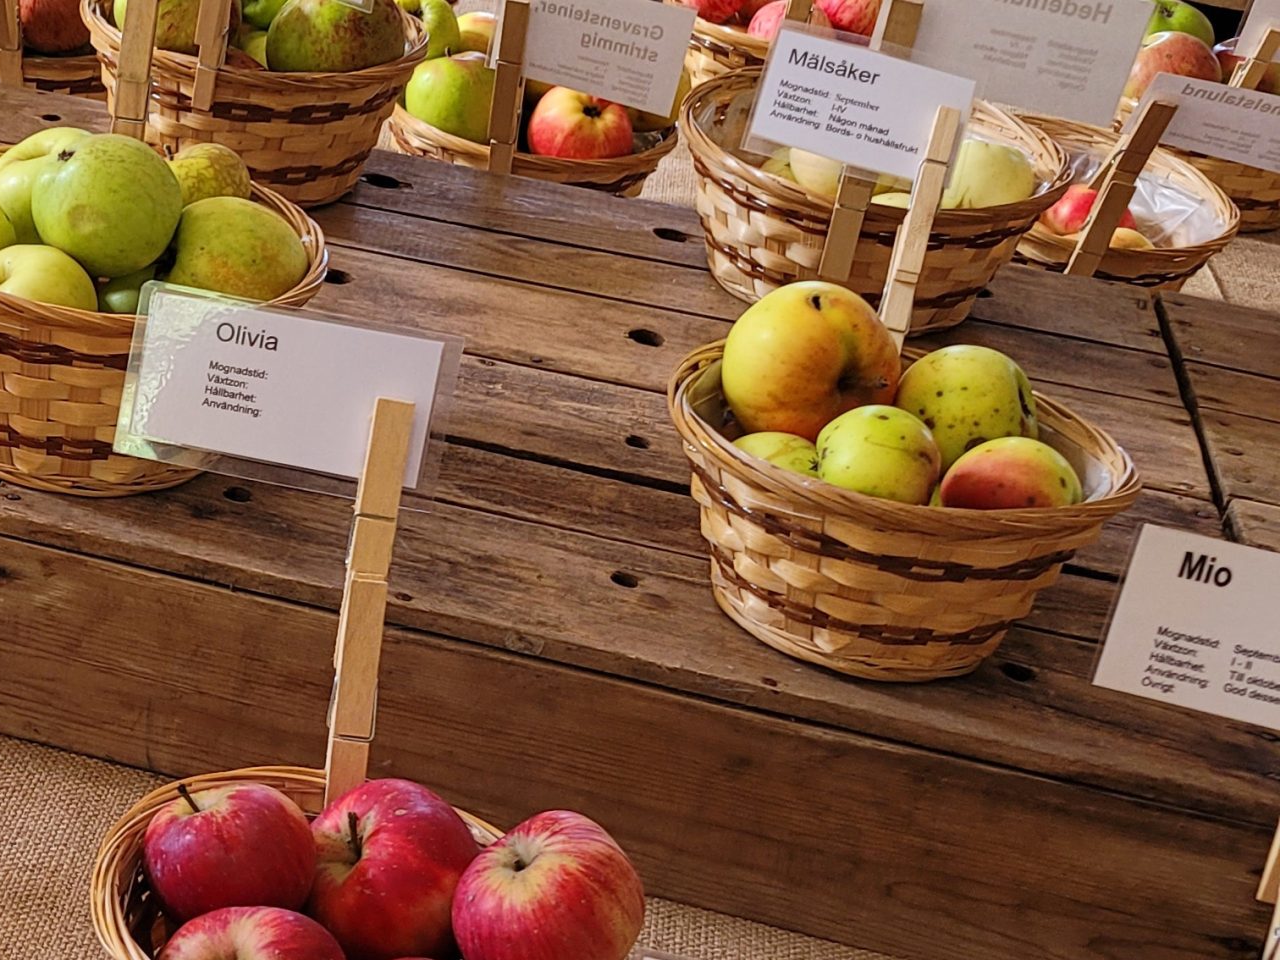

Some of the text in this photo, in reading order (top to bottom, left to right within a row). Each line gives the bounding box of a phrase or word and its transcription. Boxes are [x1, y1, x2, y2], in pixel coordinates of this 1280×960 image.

[788, 48, 880, 85] Mälsåker
[835, 93, 881, 112] September
[828, 113, 857, 128] Någon
[859, 122, 890, 136] månad
[826, 124, 854, 137] Bords-
[856, 132, 863, 140] o
[863, 134, 920, 155] hushållsfrukt
[216, 322, 279, 352] Olivia
[208, 360, 269, 380] Mognadstid:
[207, 372, 249, 389] Växtzon:
[204, 385, 257, 403] Hållbarhet:
[201, 397, 263, 418] Användning:
[1177, 551, 1233, 588] Mio
[1229, 670, 1245, 682] Till
[1223, 683, 1248, 697] God
